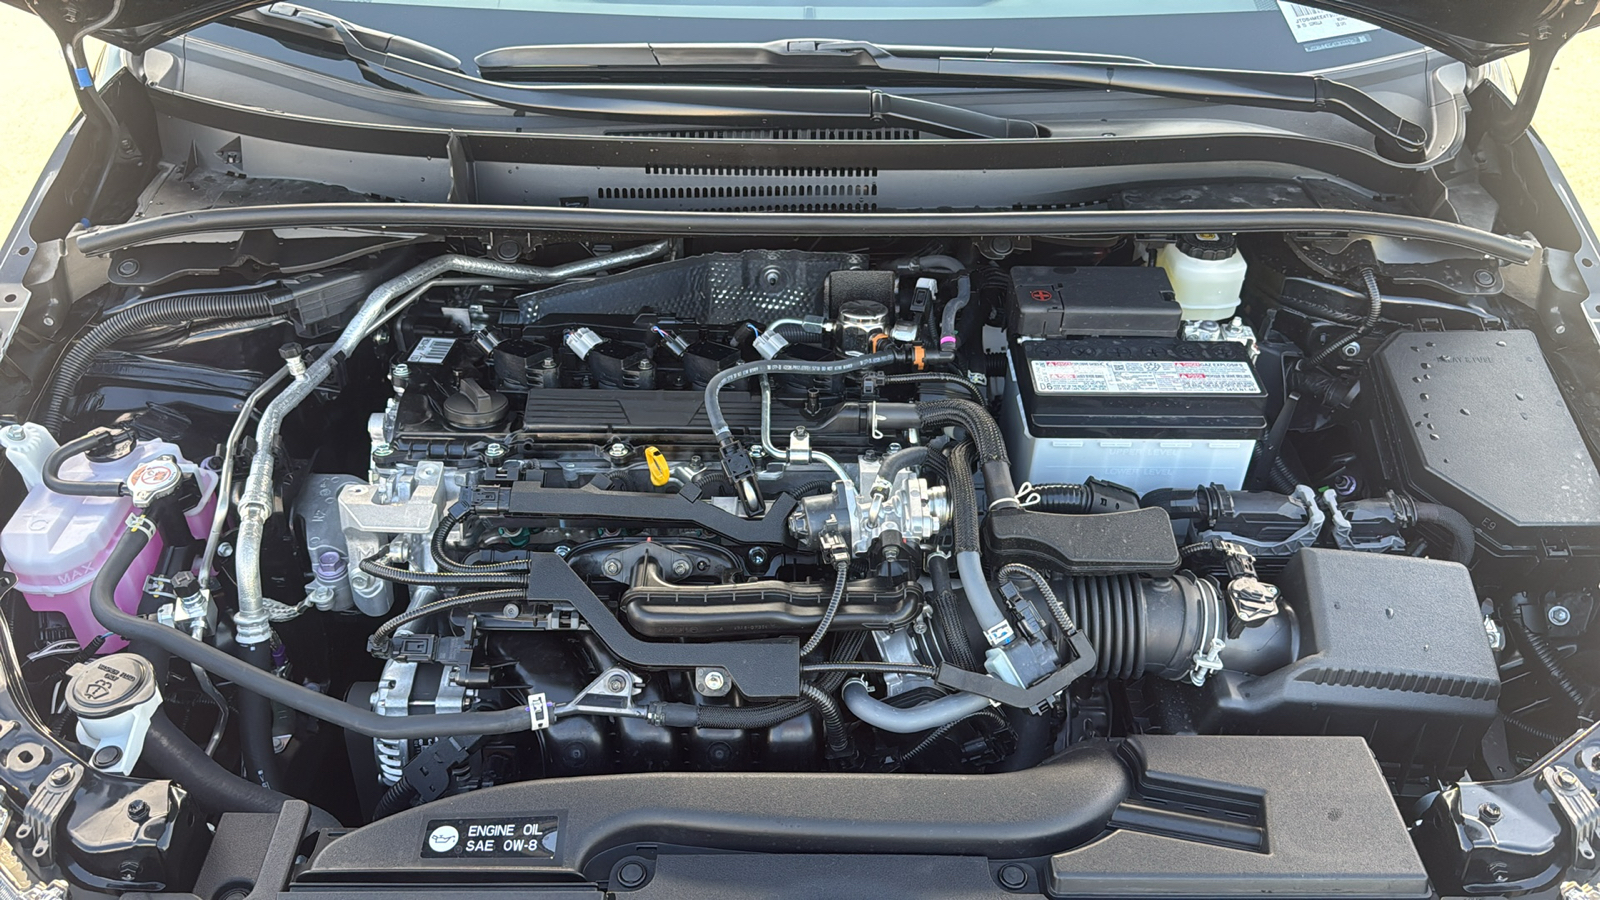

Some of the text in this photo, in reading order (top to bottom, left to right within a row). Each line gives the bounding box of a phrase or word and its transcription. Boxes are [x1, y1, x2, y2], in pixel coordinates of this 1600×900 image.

[1109, 448, 1178, 456] UPPER LEVEL
[1104, 468, 1173, 476] LOWER LEVEL
[1481, 517, 1496, 530] E9
[57, 562, 95, 585] MAX
[468, 823, 543, 837] ENGINE OIL
[465, 839, 538, 852] SAE 0W-8
